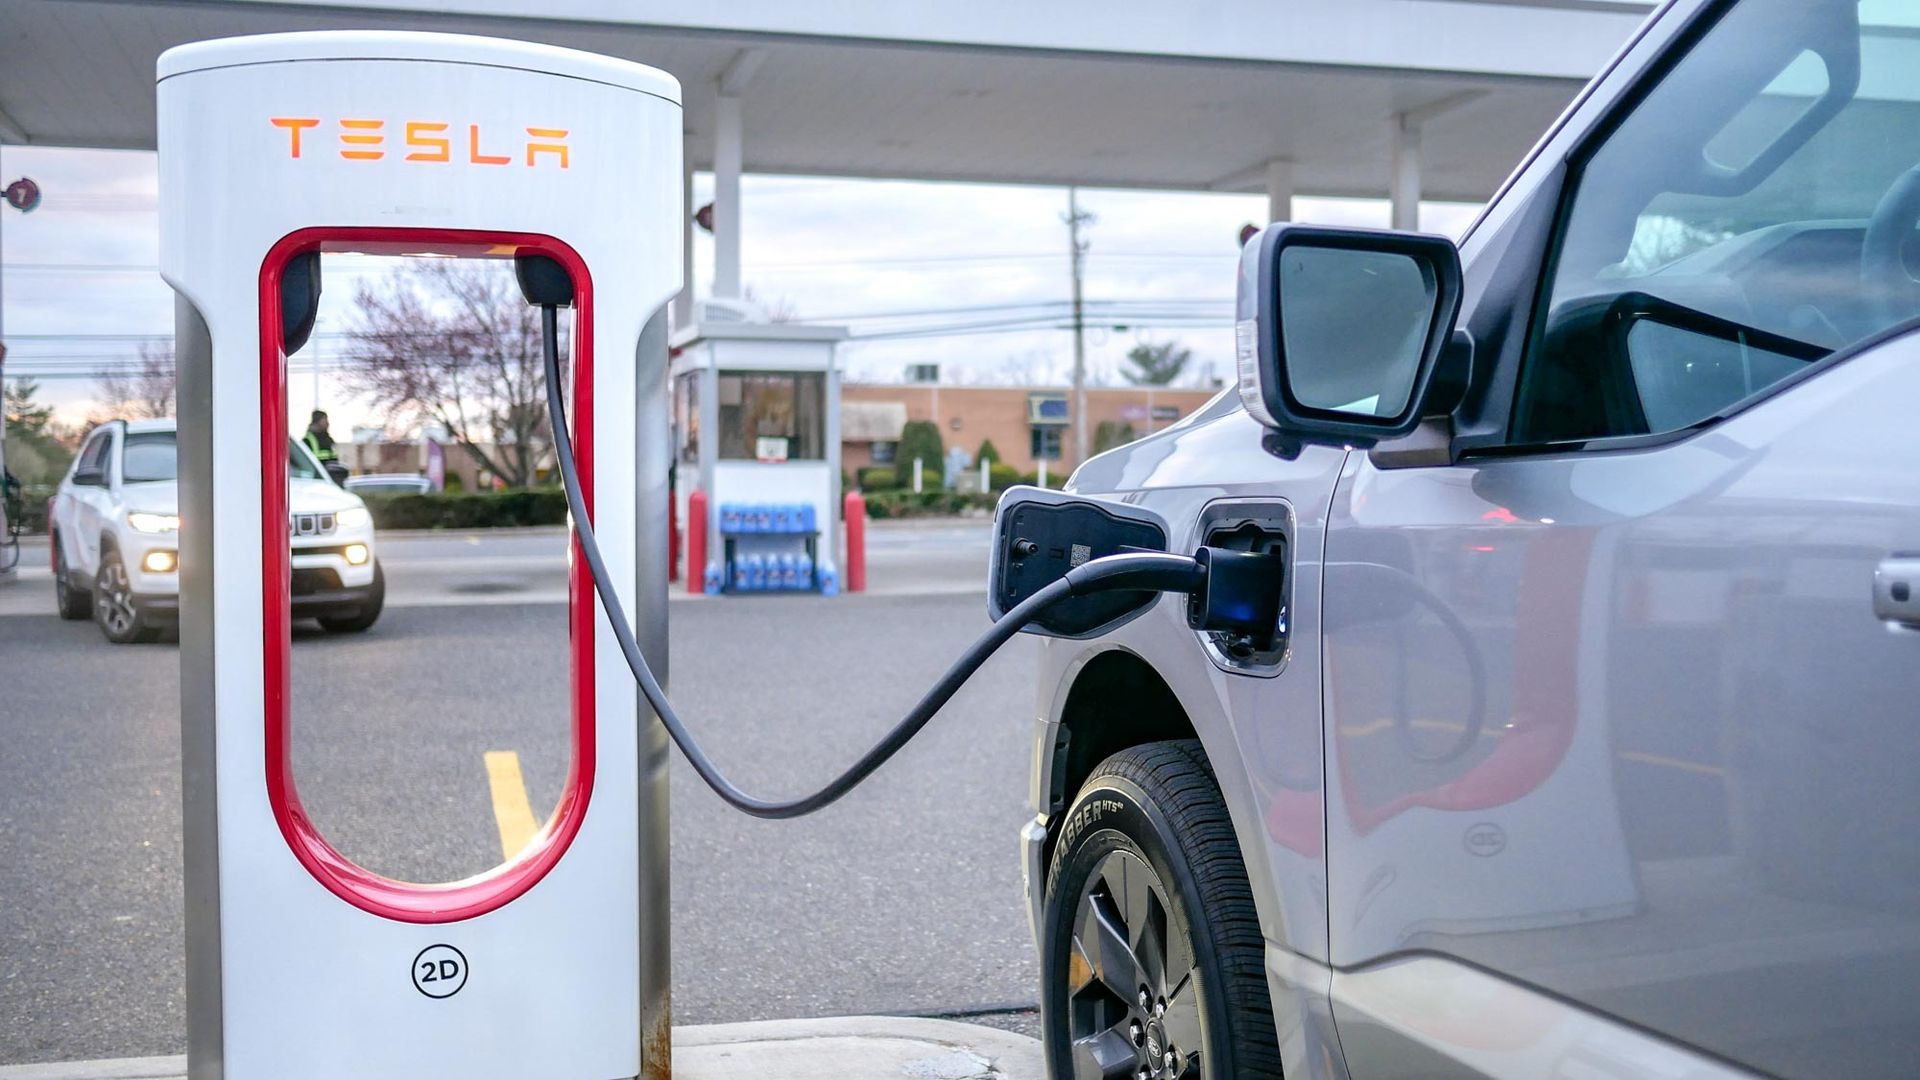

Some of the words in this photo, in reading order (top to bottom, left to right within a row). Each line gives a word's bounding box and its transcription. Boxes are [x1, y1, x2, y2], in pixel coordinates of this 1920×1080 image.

[270, 118, 569, 169] TESLA
[16, 187, 28, 205] 7
[421, 959, 459, 983] 2D
